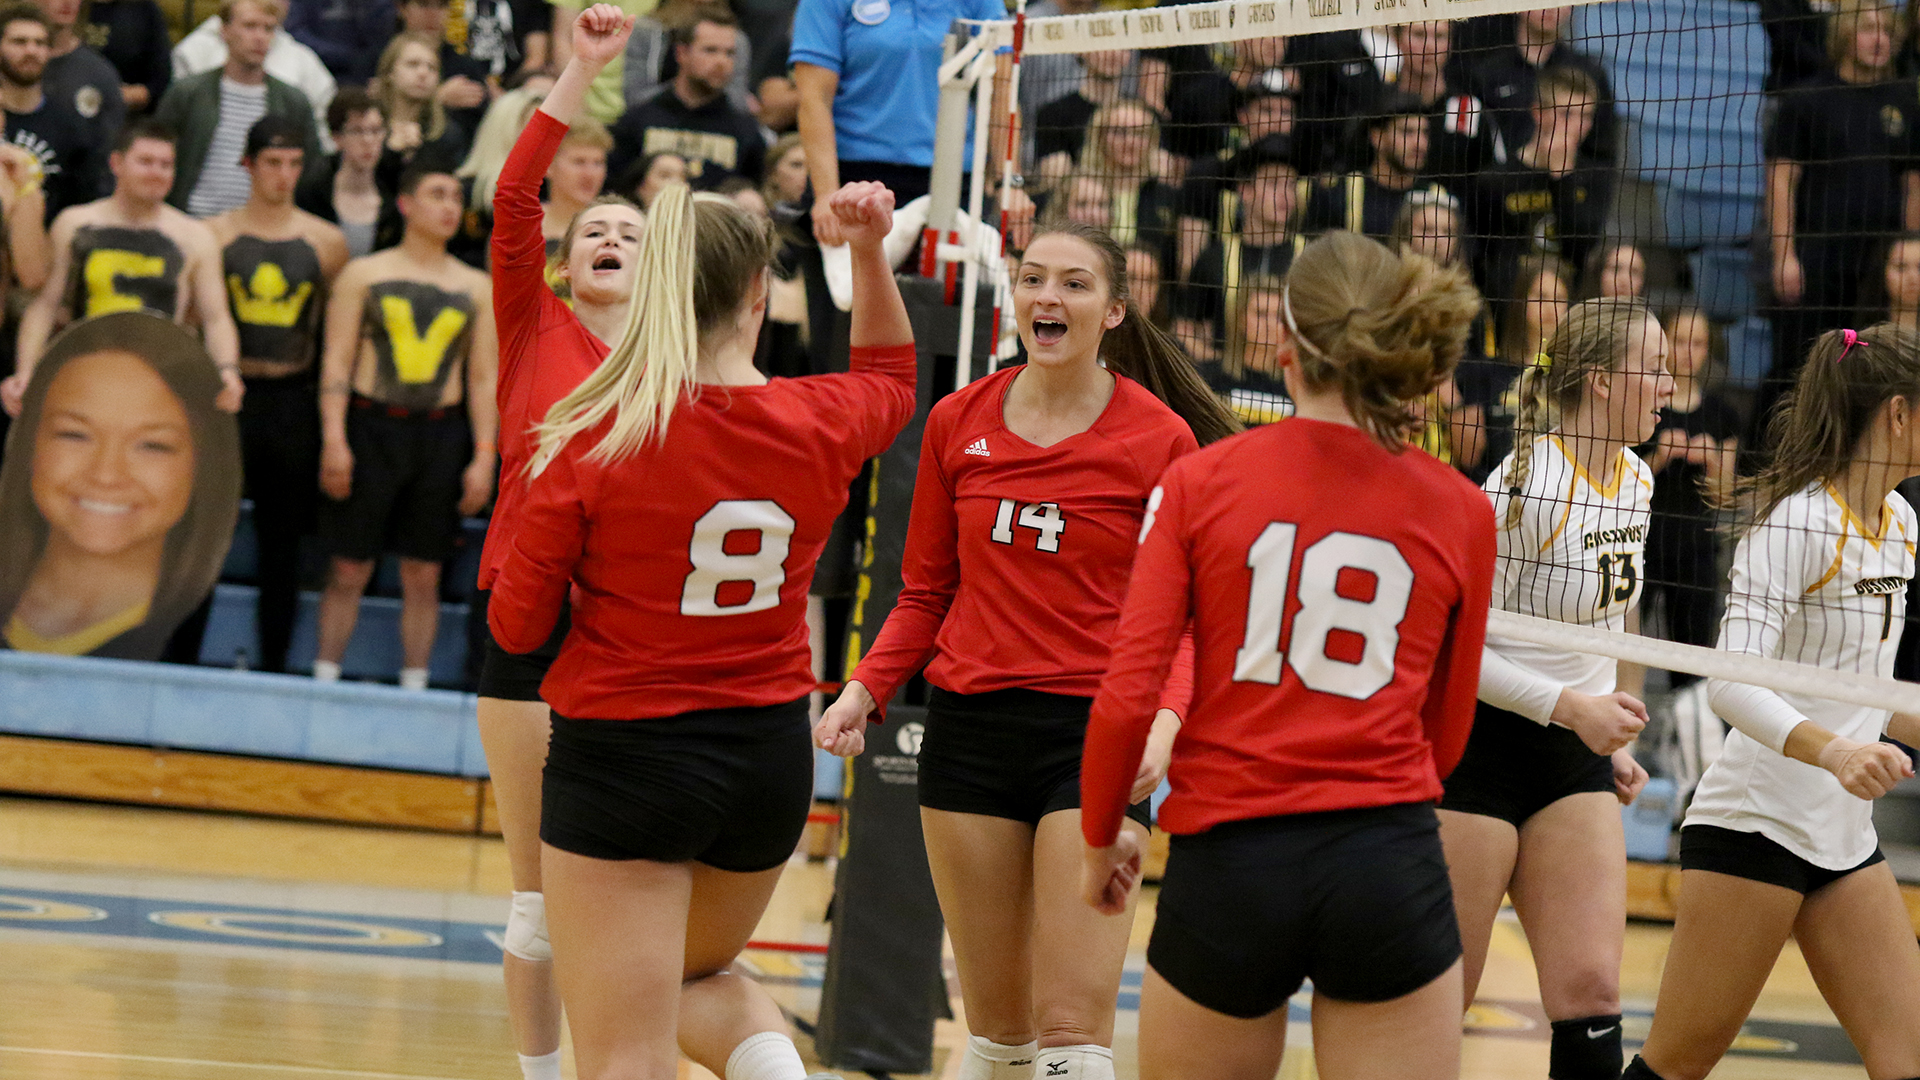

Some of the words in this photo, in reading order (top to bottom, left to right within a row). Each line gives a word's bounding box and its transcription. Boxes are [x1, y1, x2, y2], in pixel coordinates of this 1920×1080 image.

[381, 296, 467, 383] V
[964, 448, 991, 457] adidas
[680, 498, 797, 617] 8
[991, 498, 1067, 554] 14
[1232, 520, 1416, 701] 18
[1597, 551, 1638, 610] 13
